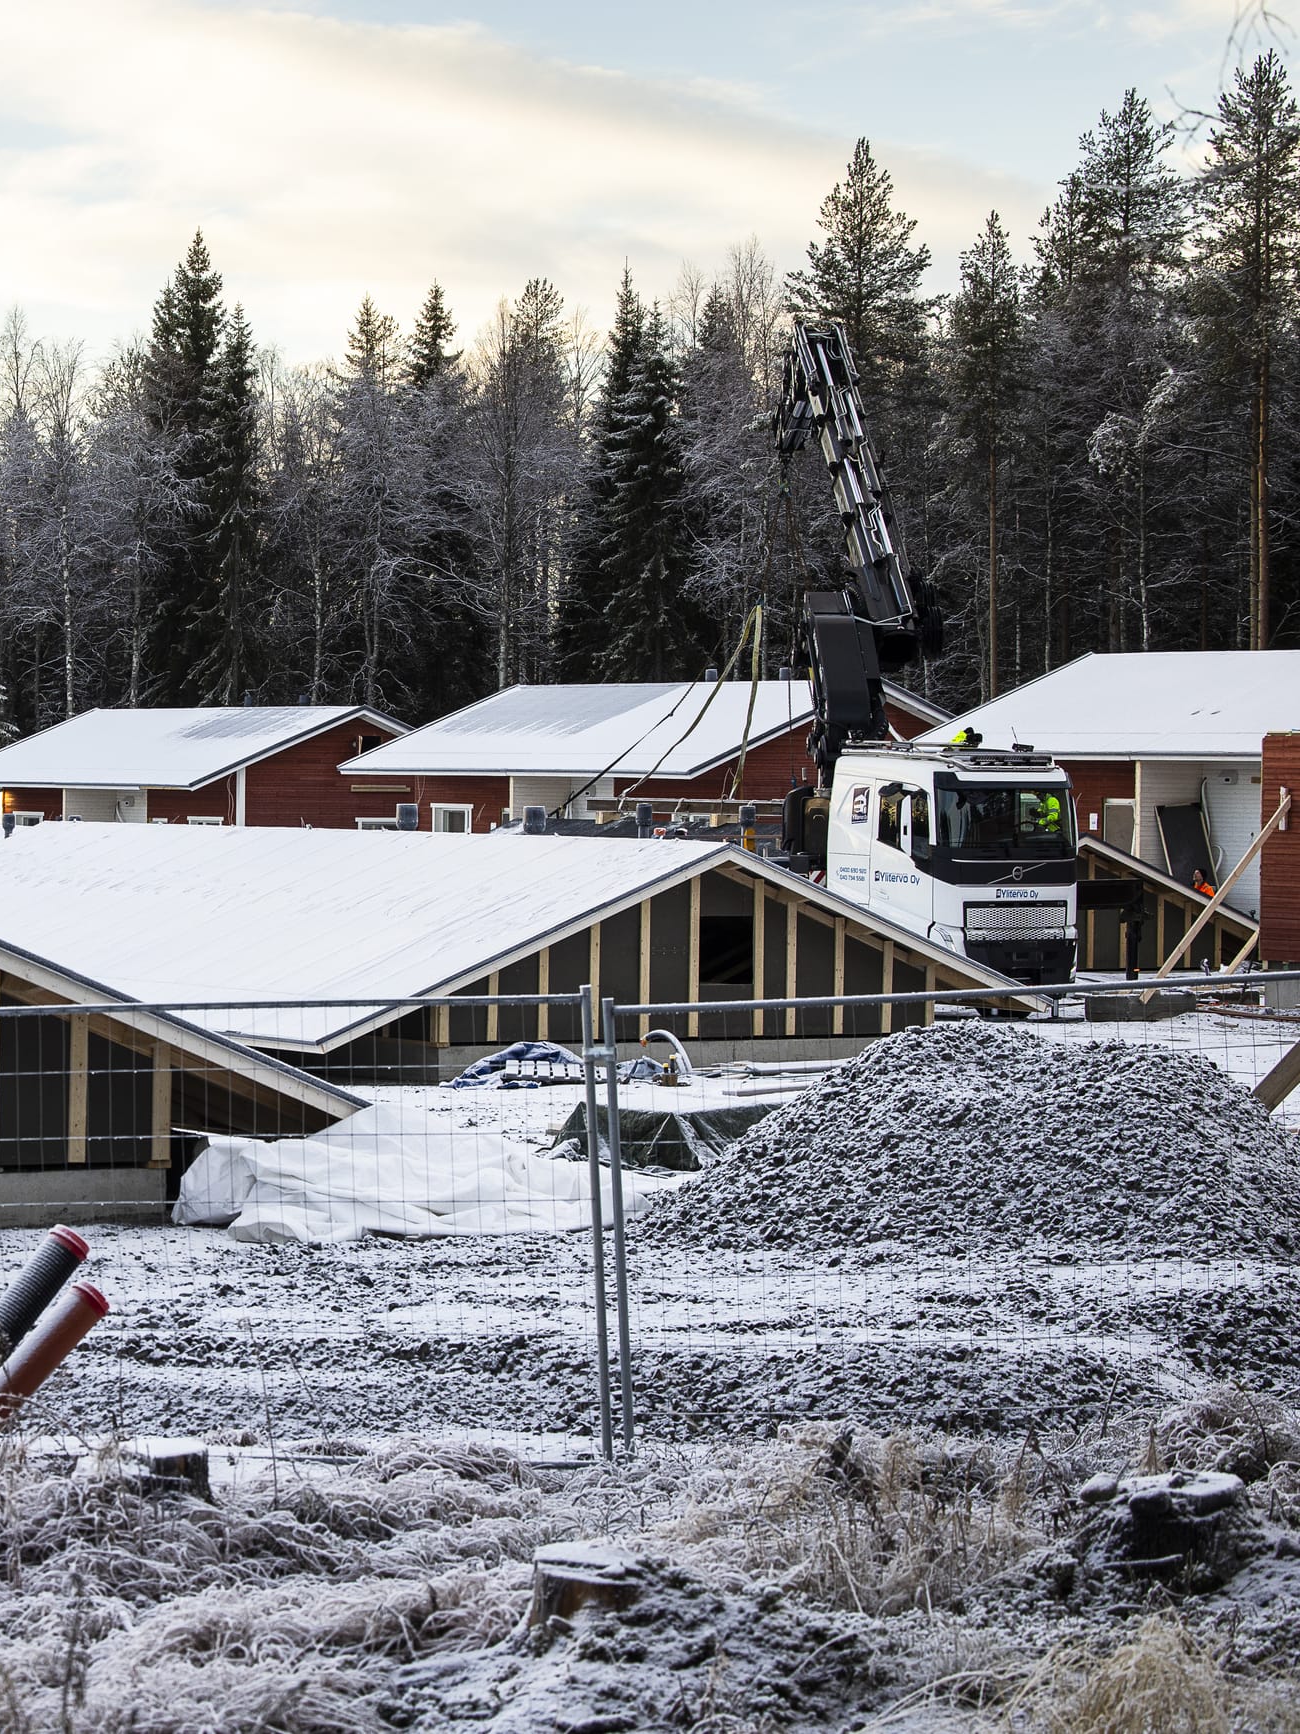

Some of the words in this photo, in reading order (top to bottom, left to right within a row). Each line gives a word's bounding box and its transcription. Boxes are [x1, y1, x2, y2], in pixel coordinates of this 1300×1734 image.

[880, 872, 908, 883] Ylitervo
[910, 875, 920, 885] Oy
[1001, 889, 1028, 897] Ylitervo
[1030, 890, 1038, 899] Oy
